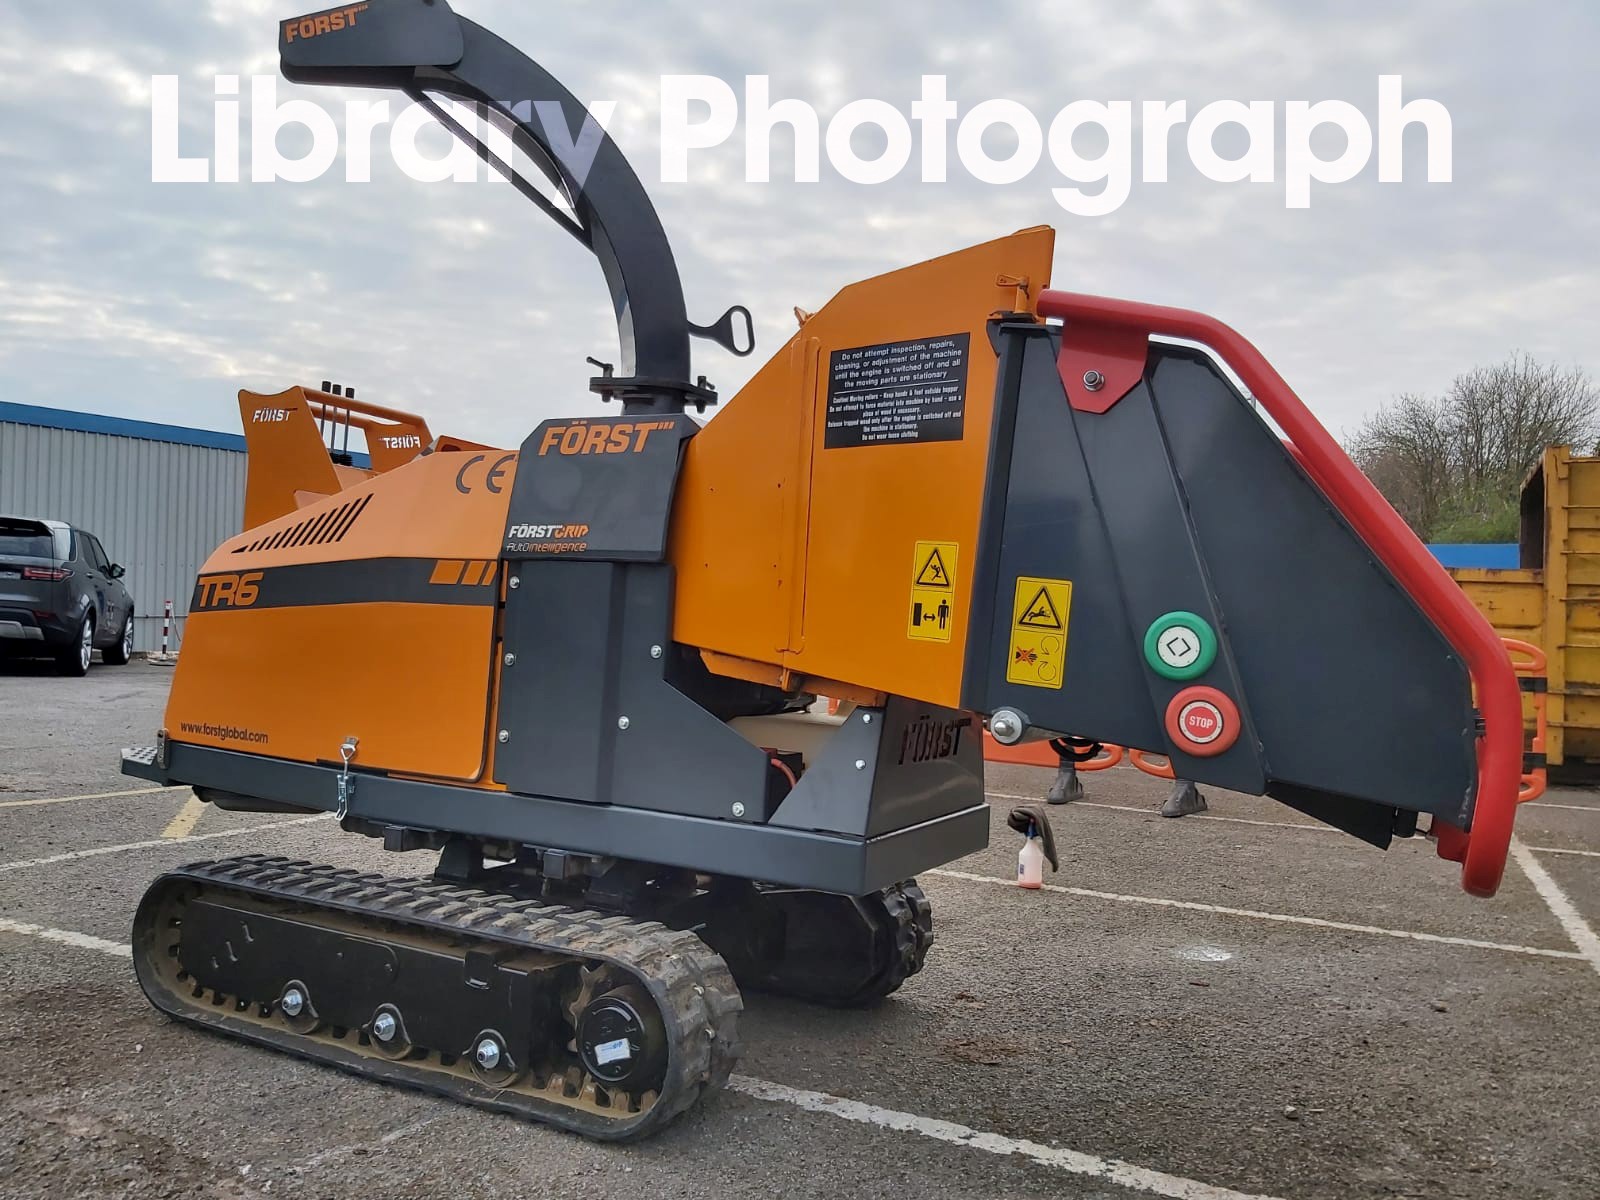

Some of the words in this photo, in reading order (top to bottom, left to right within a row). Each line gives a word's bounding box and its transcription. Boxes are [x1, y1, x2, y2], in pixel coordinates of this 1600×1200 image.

[285, 5, 366, 43] FÖRST
[864, 348, 889, 358] attempt
[929, 340, 954, 350] repairs,
[872, 356, 908, 367] adjustment
[932, 349, 962, 358] machine
[834, 372, 848, 380] until
[862, 369, 882, 377] engine
[892, 363, 922, 373] switched
[924, 362, 934, 370] off
[936, 360, 950, 368] and
[952, 358, 960, 367] all
[856, 378, 878, 386] moving
[880, 376, 897, 384] parts
[912, 371, 947, 380] stationary
[538, 420, 672, 456] FÖRST
[198, 572, 264, 608] TR6
[180, 721, 269, 744] www.forstglobal.com
[1189, 715, 1214, 729] STOP
